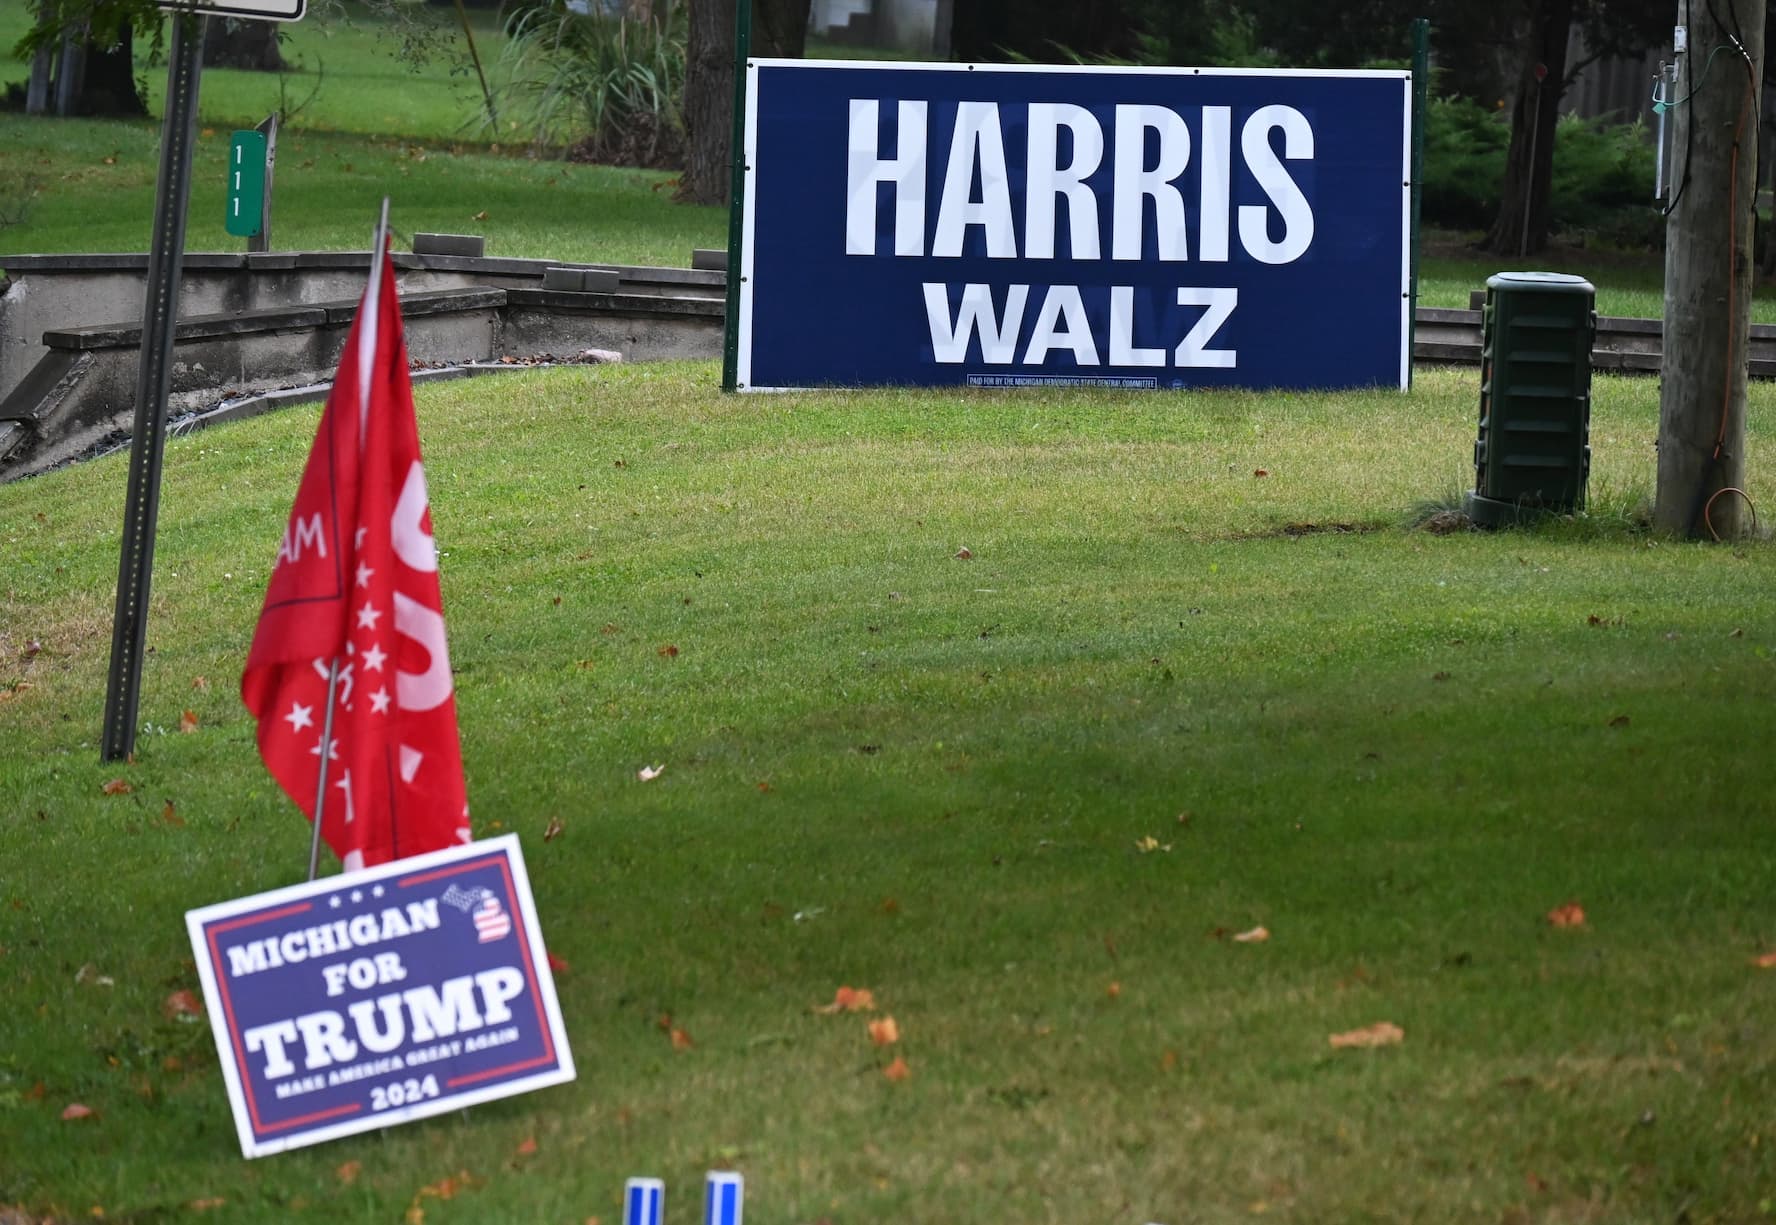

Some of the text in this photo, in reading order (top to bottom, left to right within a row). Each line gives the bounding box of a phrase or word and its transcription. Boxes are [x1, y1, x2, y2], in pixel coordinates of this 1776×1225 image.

[233, 145, 242, 216] 111
[845, 98, 1315, 264] HARRIS
[922, 282, 1238, 368] WALZ
[969, 376, 982, 385] PAID
[983, 376, 994, 385] FOR
[995, 377, 1003, 385] BY
[1004, 377, 1014, 385] THE
[1015, 377, 1043, 386] MICHIGAN
[1122, 379, 1154, 388] COMMITTEE
[227, 898, 440, 977] MICHIGAN
[322, 951, 407, 997] FOR
[244, 966, 525, 1080] TRUMP
[275, 1026, 520, 1099] MAKE AMERICA GREAT AGAIN
[370, 1073, 440, 1111] 2024
